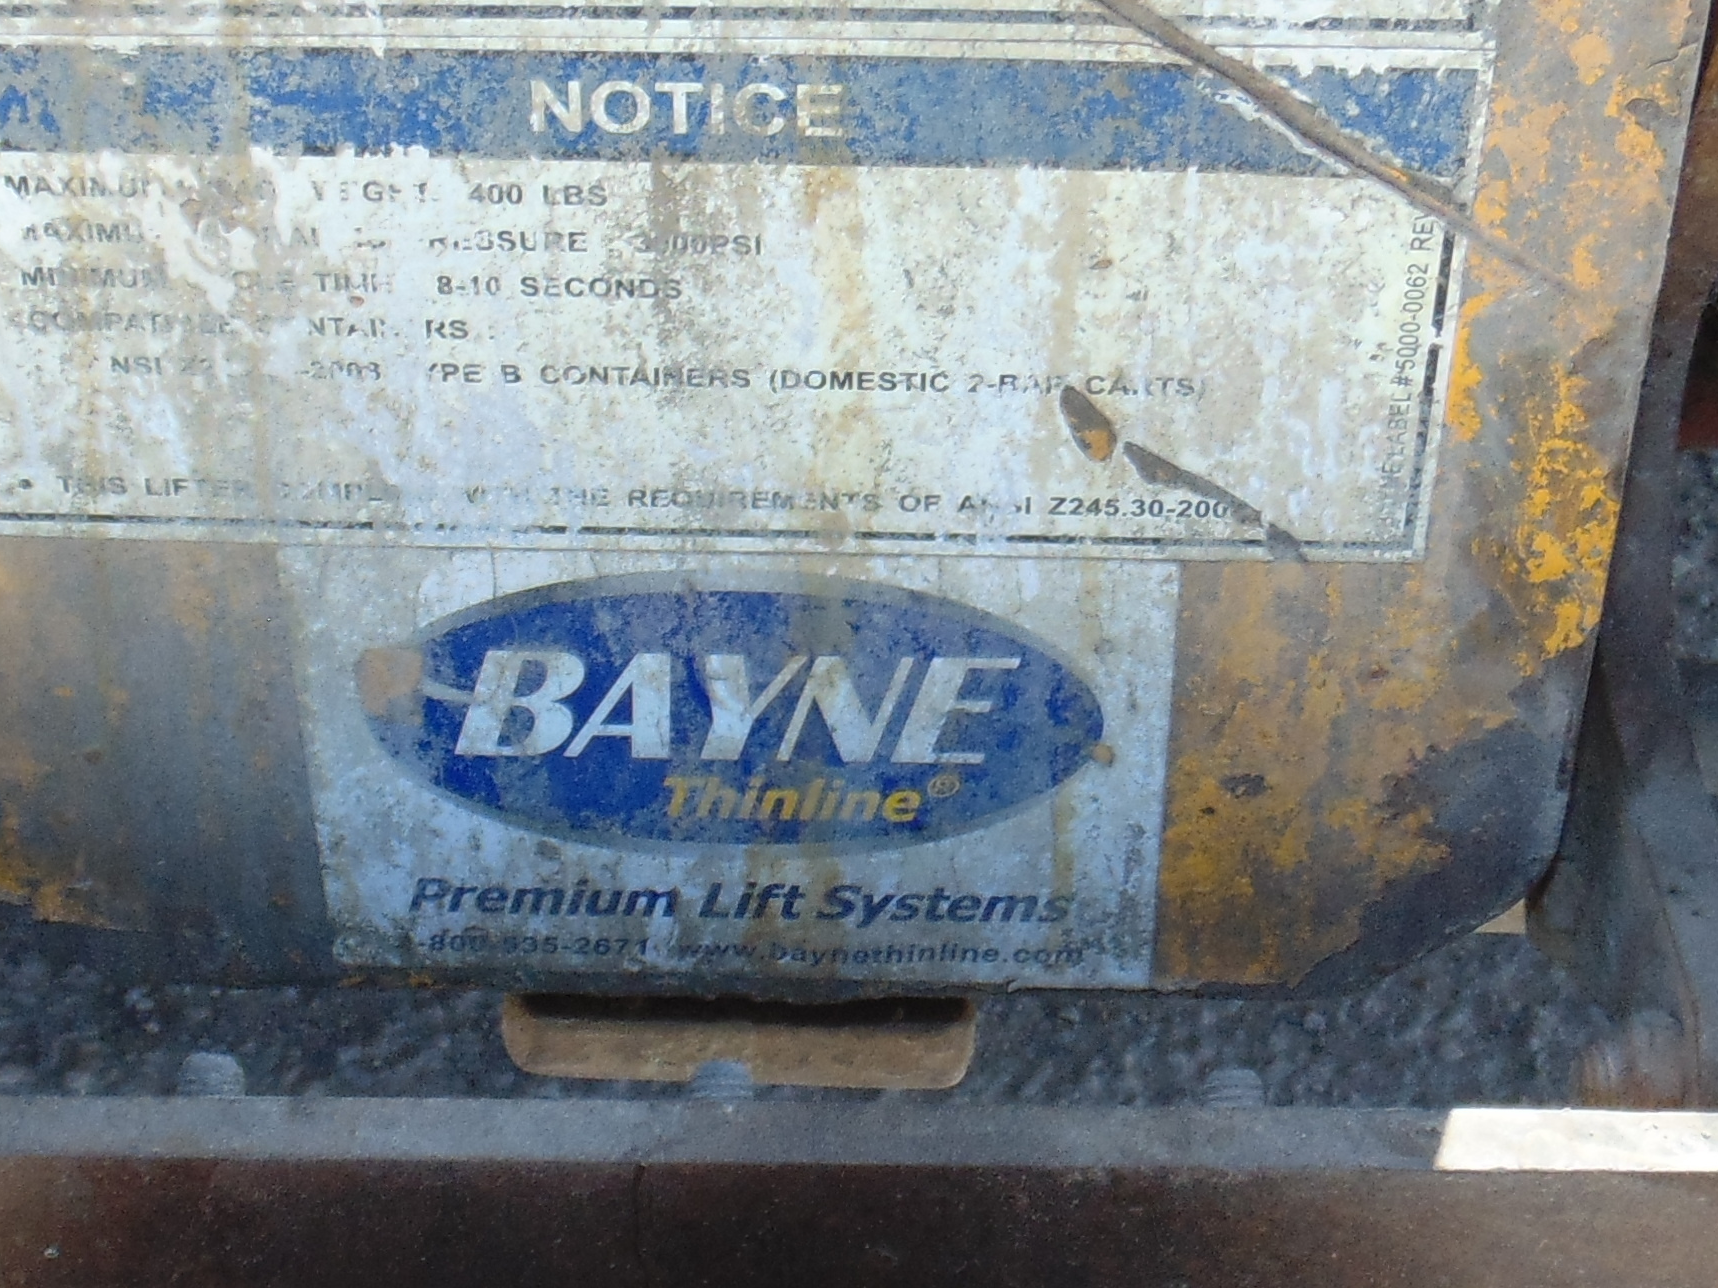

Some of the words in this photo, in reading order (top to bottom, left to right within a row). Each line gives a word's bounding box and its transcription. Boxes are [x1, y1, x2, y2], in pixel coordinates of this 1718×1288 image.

[527, 79, 845, 139] NOTICE
[468, 182, 523, 206] 400
[542, 183, 609, 208] LBS
[436, 275, 500, 297] 8-10
[519, 275, 684, 302] SECONDS
[501, 363, 523, 384] B
[539, 363, 752, 390] CONTAINERS
[768, 368, 950, 395] (DOMESTIC
[898, 494, 942, 513] OF
[453, 648, 1024, 767] BAYNE
[410, 877, 677, 920] Premium
[696, 880, 806, 925] Lift
[816, 882, 1072, 930] Systems
